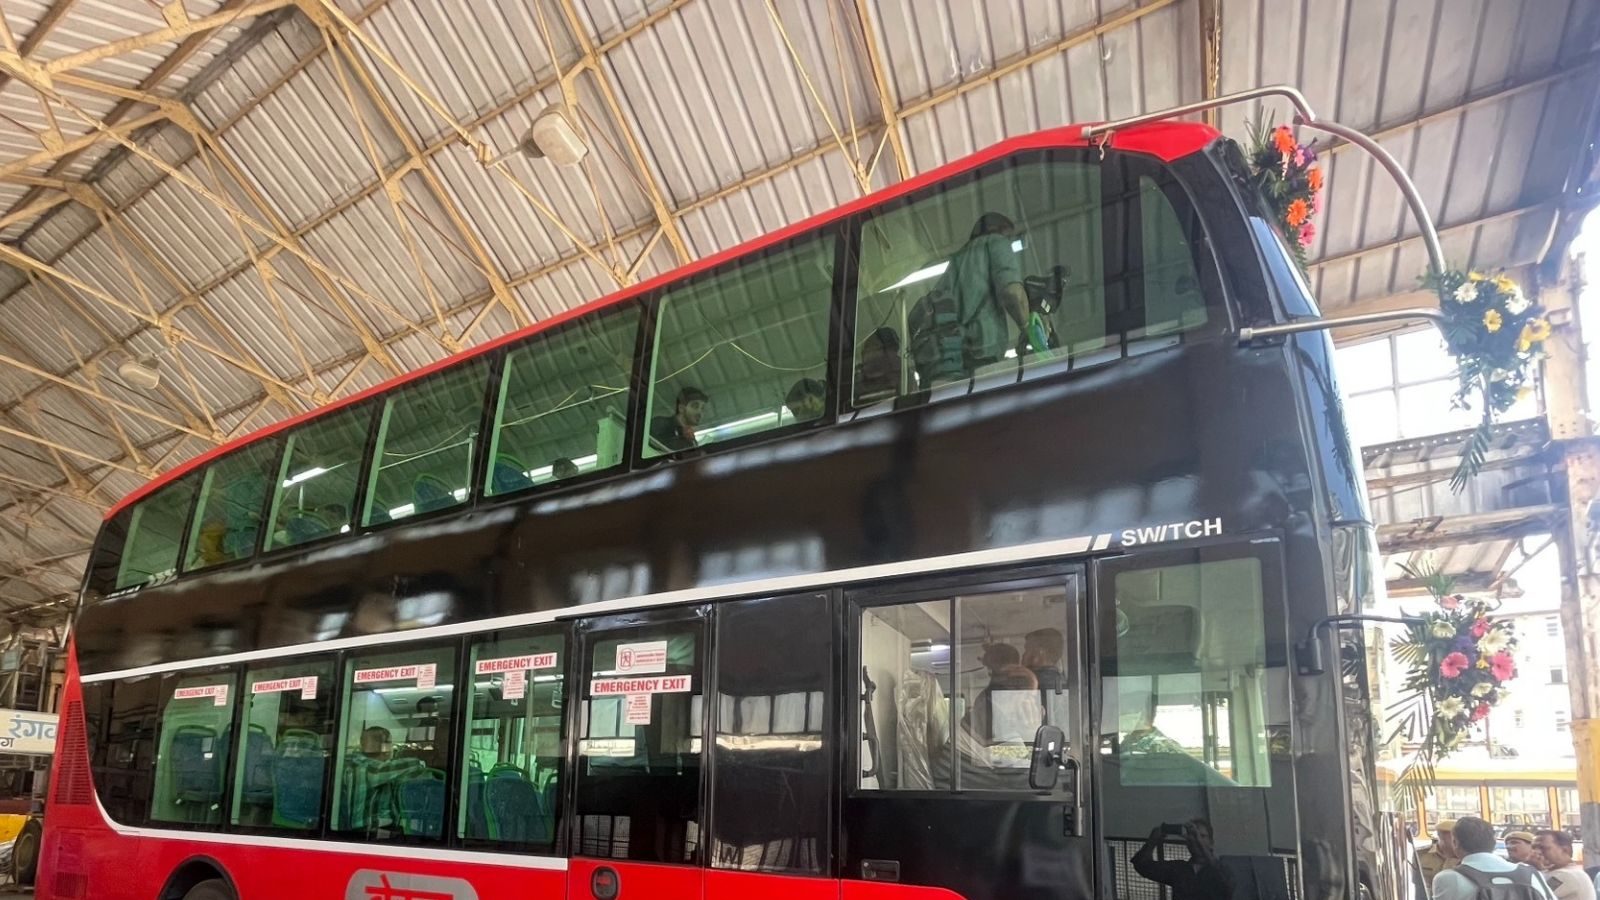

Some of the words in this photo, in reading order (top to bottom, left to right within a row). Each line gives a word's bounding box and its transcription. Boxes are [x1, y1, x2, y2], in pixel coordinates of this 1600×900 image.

[1122, 518, 1222, 546] SWITCH
[478, 656, 532, 672] EMERGENCY
[533, 655, 554, 667] EXIT
[356, 668, 400, 681] EMERGENCY
[400, 667, 416, 677] EXIT
[176, 688, 204, 698] EMERGENCY
[204, 687, 215, 695] EXIT
[254, 682, 288, 692] EMERGENCY
[288, 680, 301, 689] EXIT
[594, 679, 659, 693] EMERGENCY
[662, 677, 687, 690] EXIT
